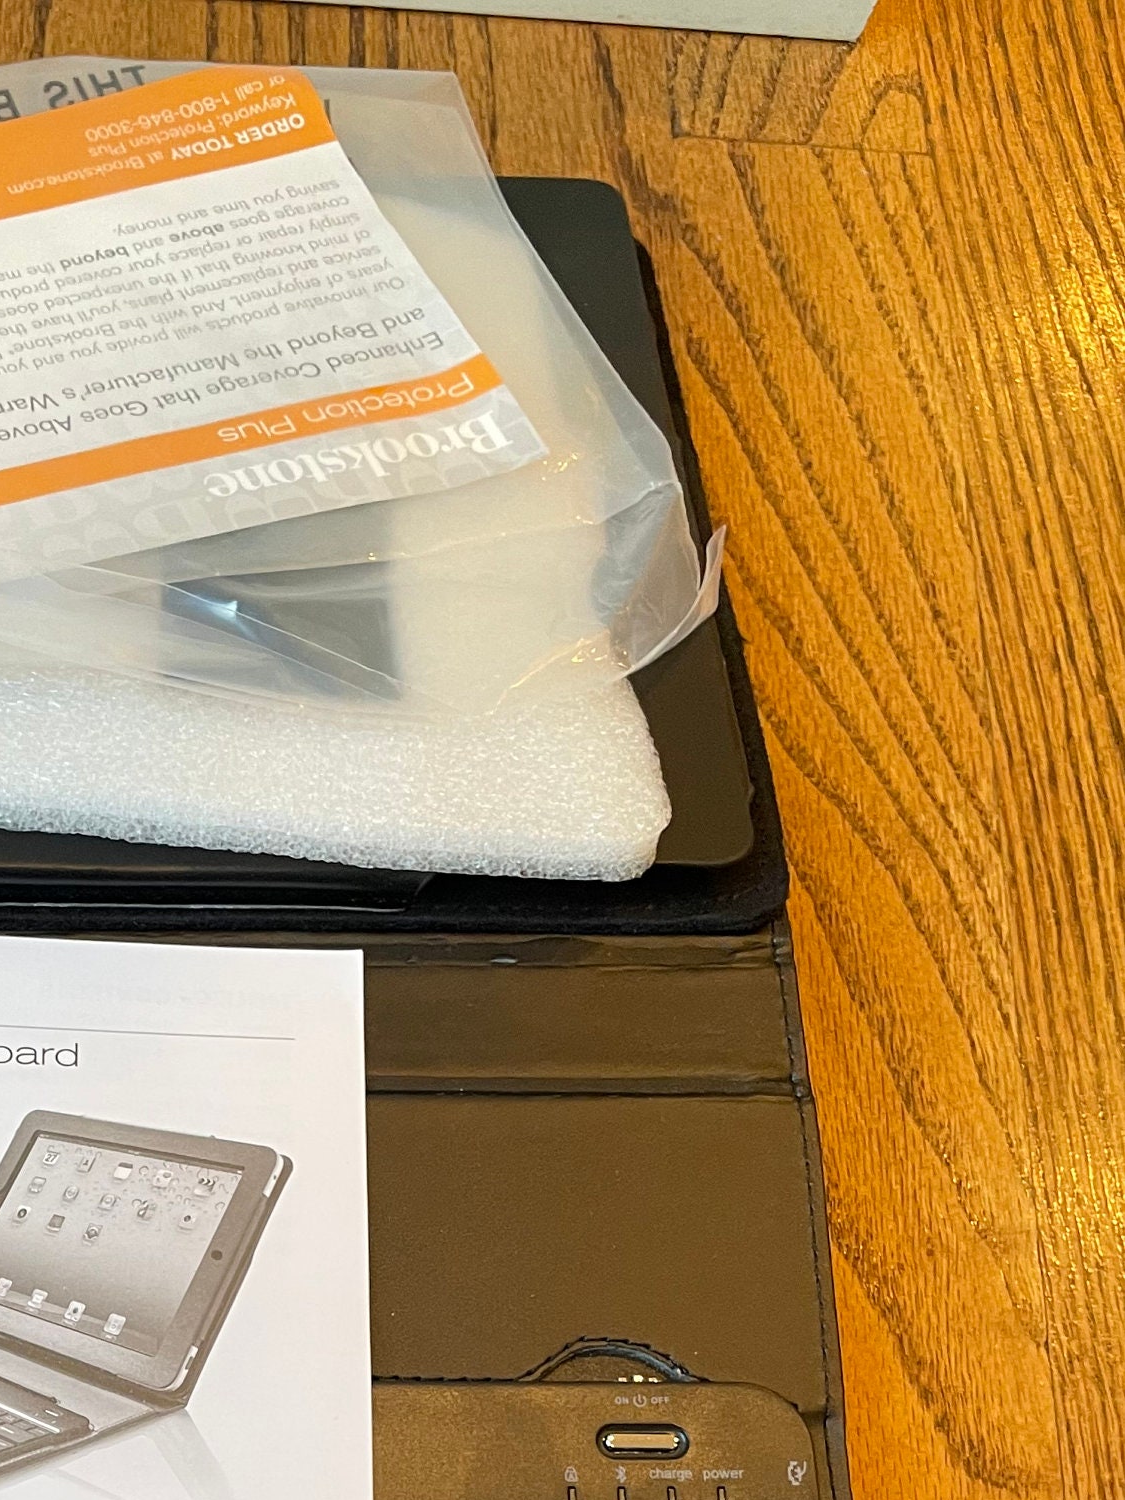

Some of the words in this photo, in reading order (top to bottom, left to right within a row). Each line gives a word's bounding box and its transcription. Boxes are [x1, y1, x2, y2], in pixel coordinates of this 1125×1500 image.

[234, 81, 267, 100] call
[269, 75, 285, 86] or
[85, 92, 230, 141] 1-800-846-3000
[221, 92, 296, 126] Keyword:
[129, 119, 215, 147] Protection
[235, 113, 305, 144] ORDER
[88, 142, 127, 156] Plus
[147, 151, 163, 164] at
[171, 135, 233, 159] TODAY
[7, 156, 145, 194] Brookstone.com
[274, 196, 349, 219] coverage
[228, 210, 270, 229] goes
[169, 223, 224, 242] above
[308, 233, 349, 253] mind
[353, 229, 370, 243] of
[132, 237, 163, 255] and
[232, 243, 305, 265] knowing
[26, 262, 56, 275] the
[59, 246, 130, 271] beyond
[194, 259, 231, 277] that
[346, 256, 394, 280] years
[148, 272, 177, 285] the
[180, 269, 193, 282] if
[325, 273, 343, 288] of
[43, 279, 145, 311] unexpected
[151, 308, 188, 324] with
[190, 298, 225, 317] And
[118, 317, 147, 329] the
[380, 307, 425, 334] and
[286, 322, 379, 355] Beyond
[243, 343, 282, 359] the
[325, 331, 444, 373] Enhanced
[61, 352, 239, 401] Manufacturer's
[205, 362, 321, 394] Coverage
[152, 388, 201, 409] that
[302, 372, 474, 422] Protection
[80, 400, 148, 422] Goes
[217, 415, 296, 442] Plus
[203, 407, 513, 496] Brookstone
[614, 1396, 629, 1405] ON
[650, 1396, 670, 1405] OFF
[649, 1467, 693, 1481] charge
[703, 1468, 745, 1481] power
